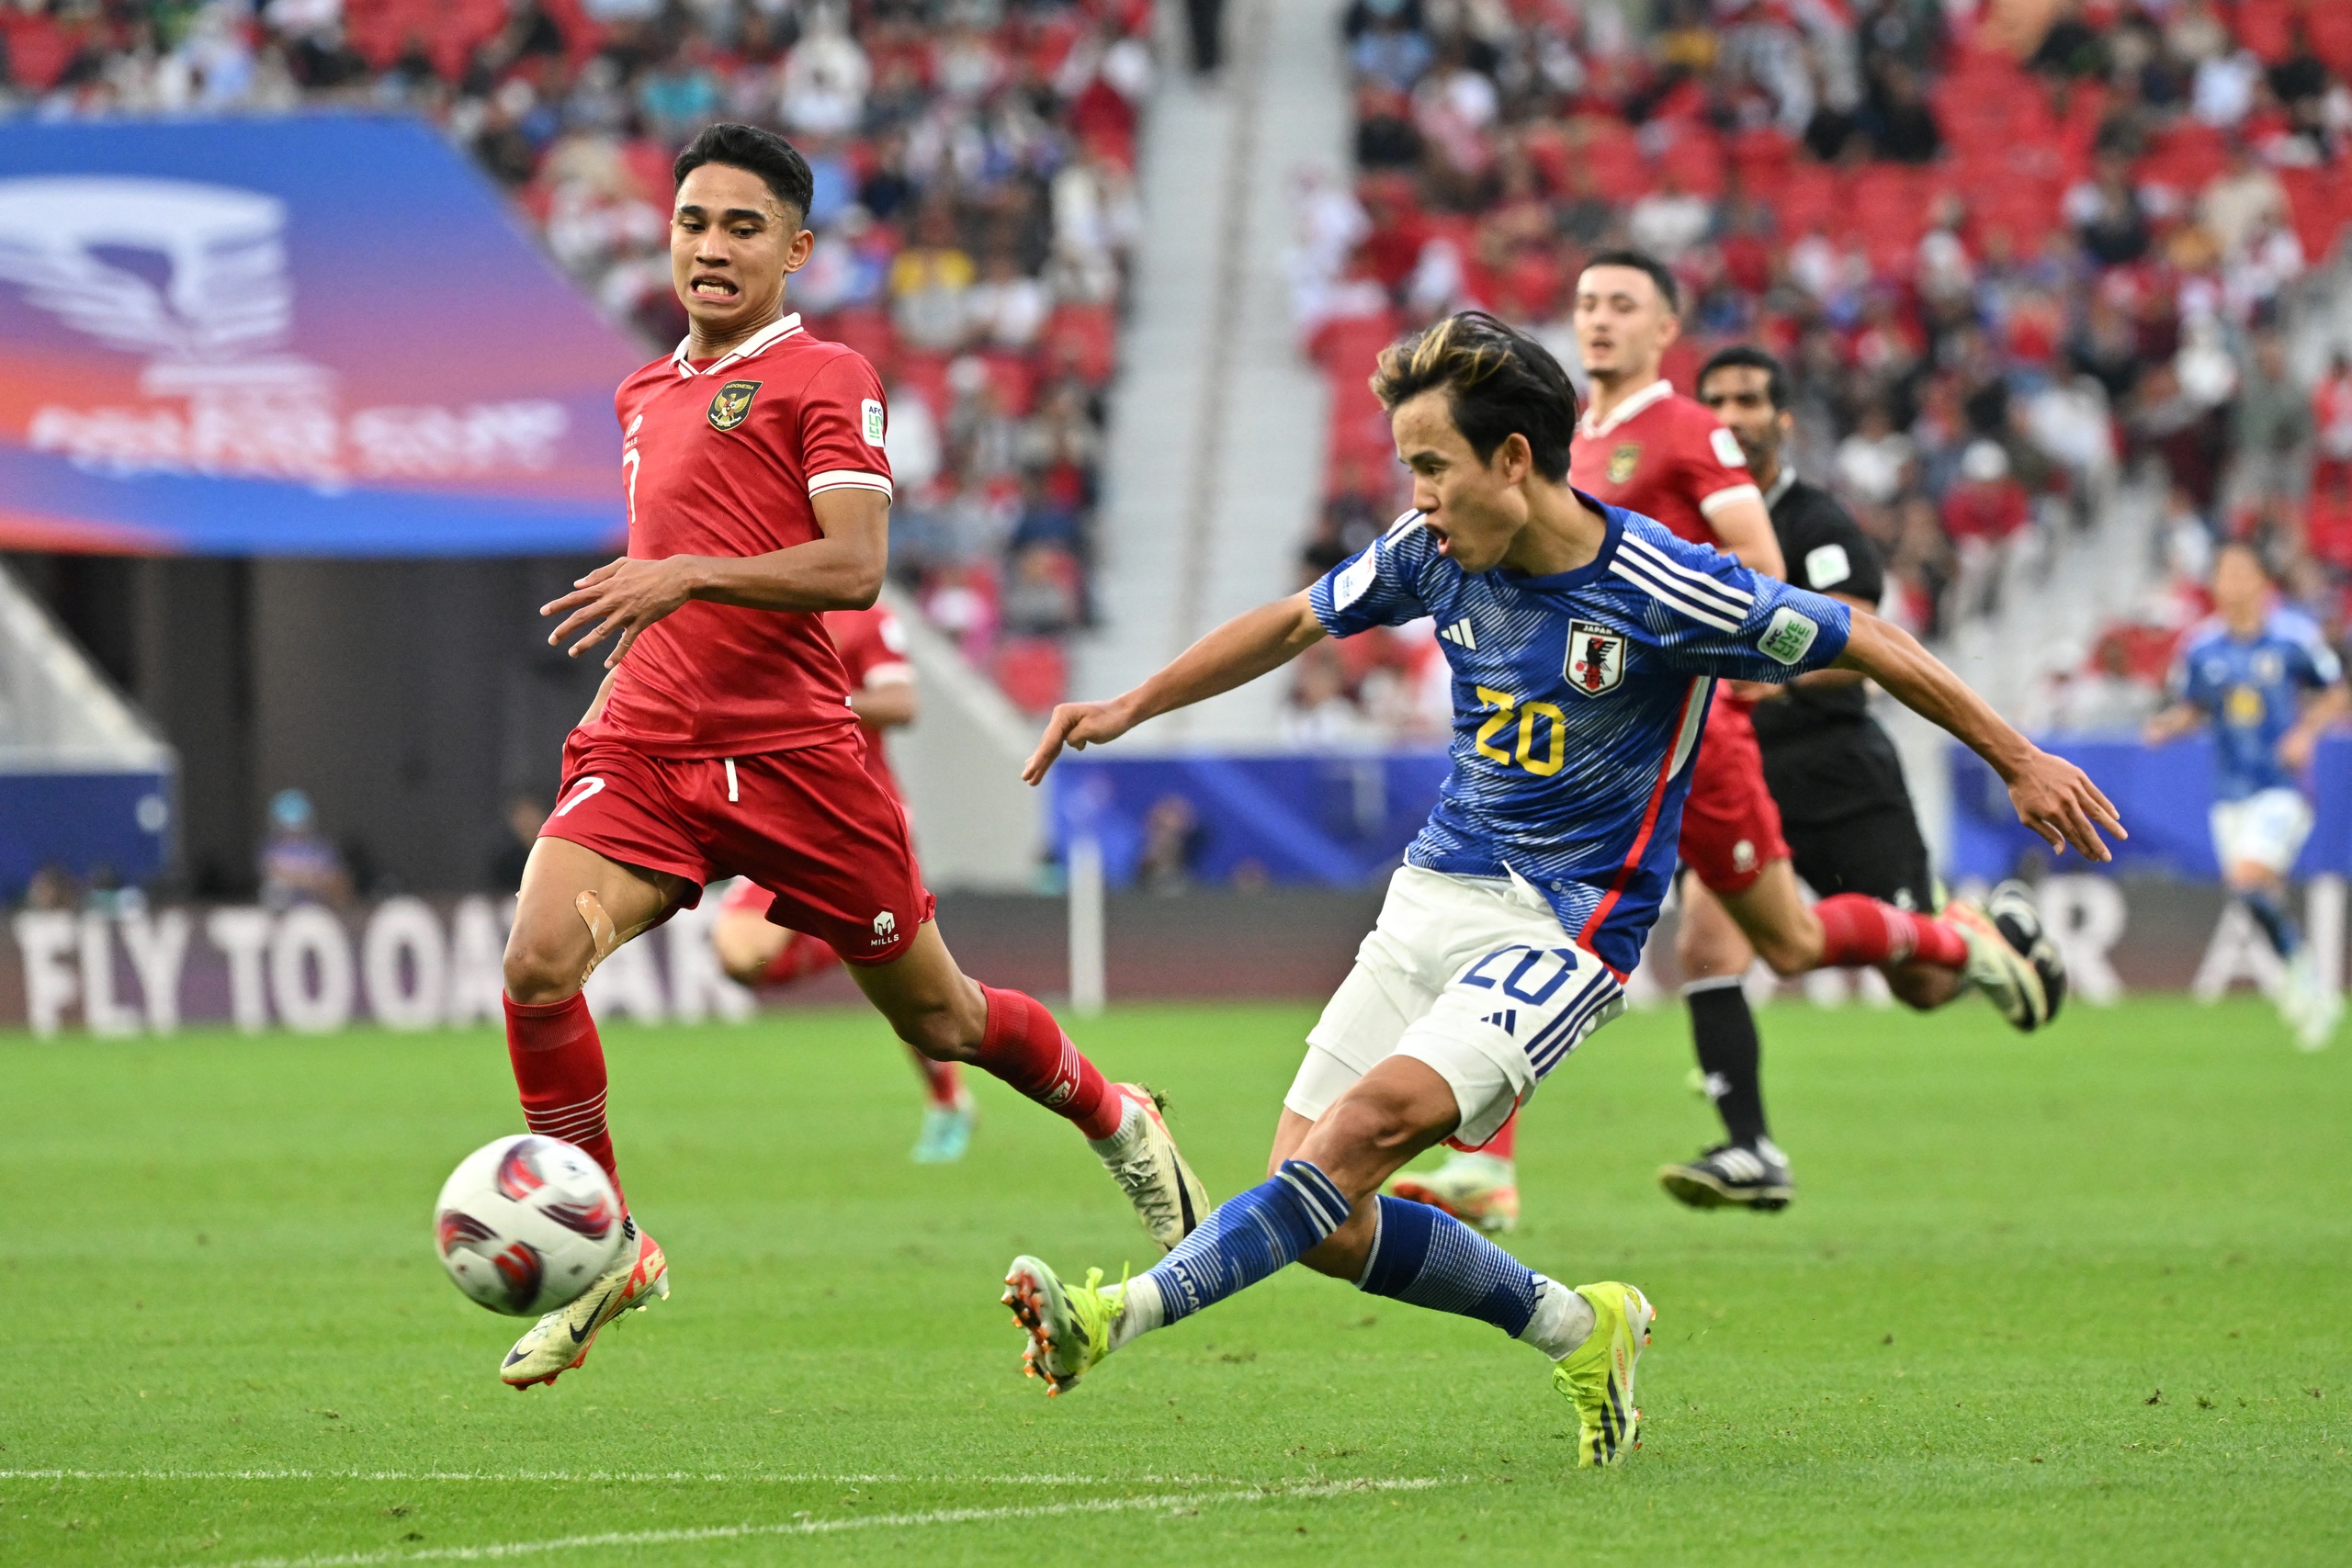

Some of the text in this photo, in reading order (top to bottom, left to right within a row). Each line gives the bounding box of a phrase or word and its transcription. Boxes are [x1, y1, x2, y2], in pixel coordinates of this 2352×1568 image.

[623, 447, 641, 525] 7
[1582, 625, 1612, 636] JAPAN
[1766, 628, 1782, 648] AFC
[1476, 685, 1566, 777] 20
[555, 776, 606, 818] 7
[870, 933, 899, 946] MILLS
[13, 908, 188, 1039] FLY
[204, 905, 355, 1035] TO
[1459, 943, 1578, 1007] 20
